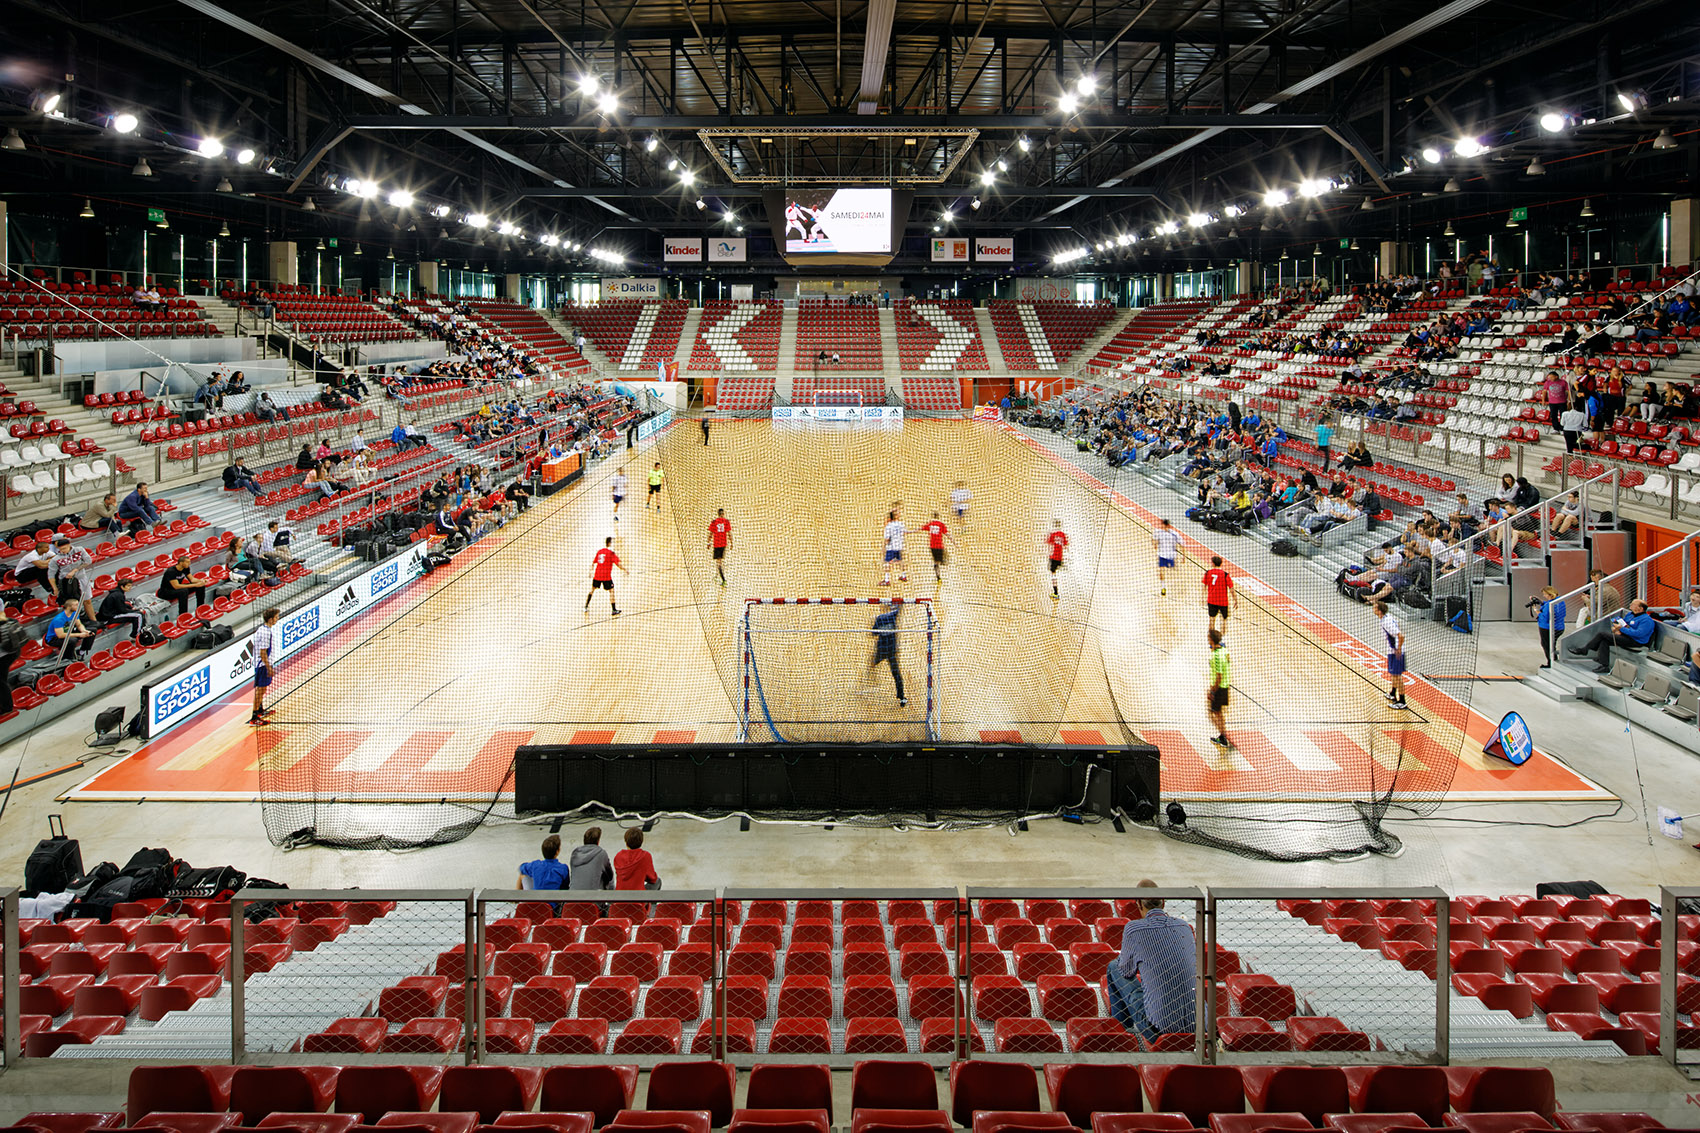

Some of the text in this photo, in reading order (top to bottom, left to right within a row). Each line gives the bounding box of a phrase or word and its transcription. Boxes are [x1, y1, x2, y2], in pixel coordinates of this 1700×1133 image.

[665, 244, 700, 255] Kinder
[977, 244, 1012, 255] Kinder
[621, 283, 656, 292] Dalkia
[372, 563, 398, 584] CASAL
[372, 572, 397, 594] SPORT
[1211, 573, 1218, 585] 7
[335, 597, 360, 617] adidas
[283, 608, 318, 634] CASAL
[283, 618, 318, 646] SPORT
[157, 671, 208, 706] CASAL
[157, 684, 208, 720] SPORT
